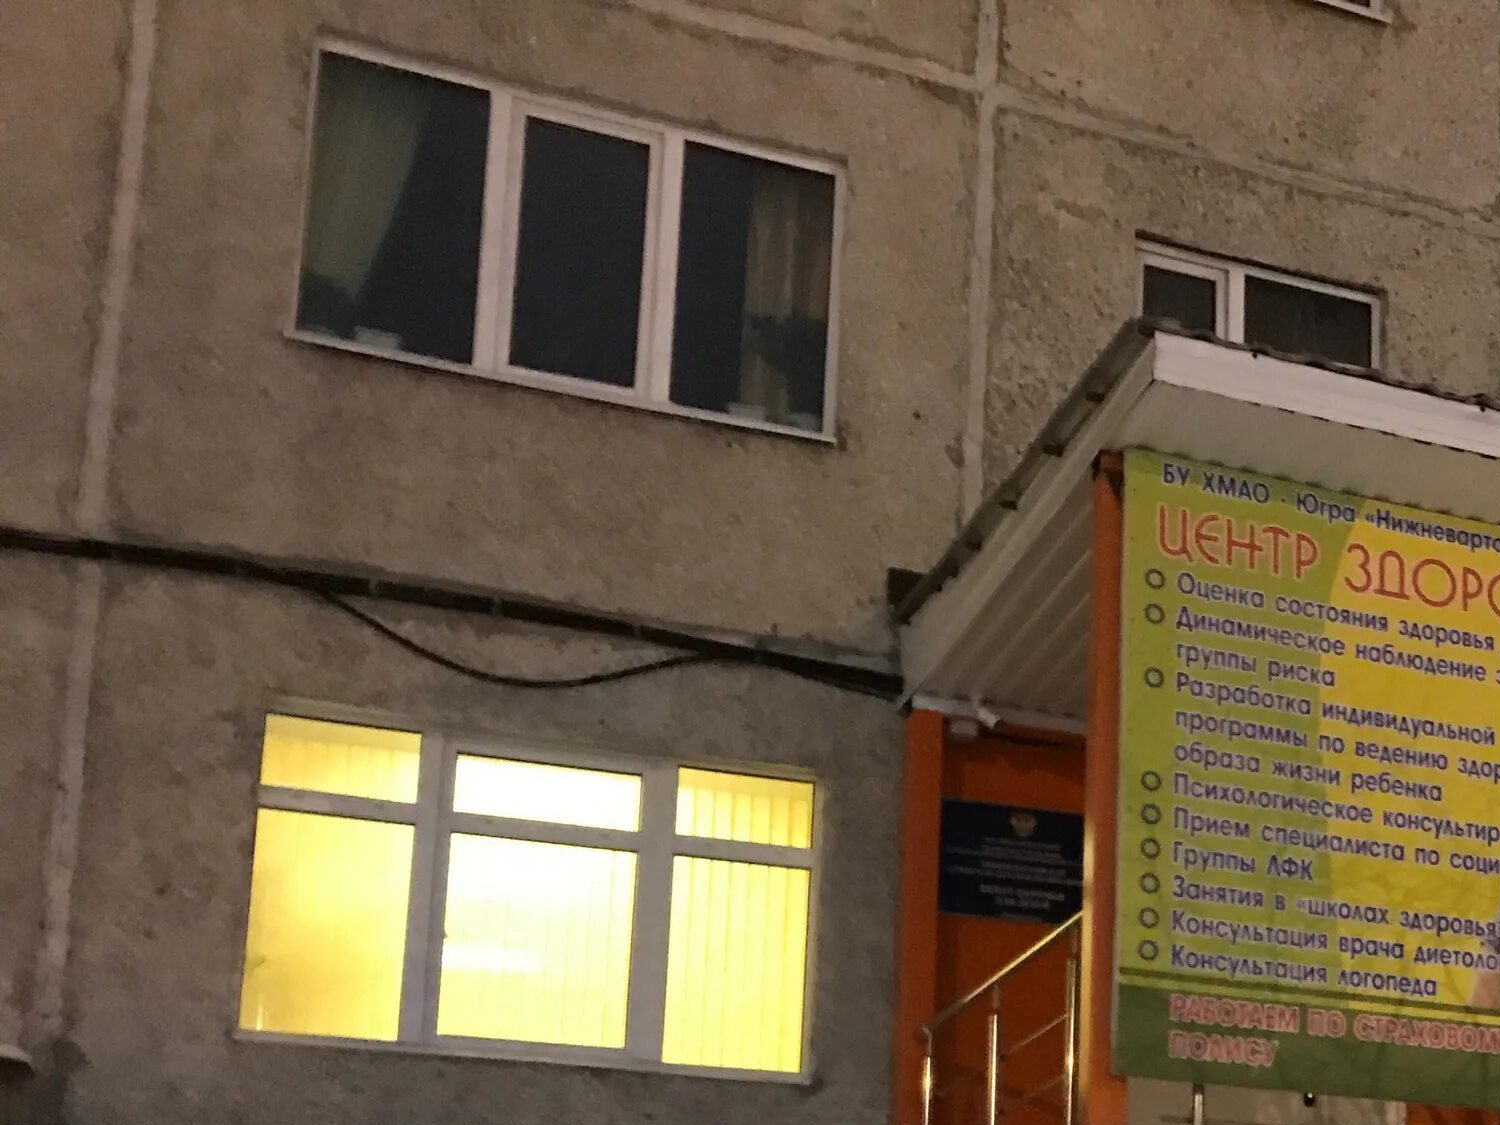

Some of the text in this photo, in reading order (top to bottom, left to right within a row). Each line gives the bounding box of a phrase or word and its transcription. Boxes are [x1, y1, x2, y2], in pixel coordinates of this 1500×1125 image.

[1163, 463, 1189, 486] БУ
[1202, 470, 1269, 503] ХМАО
[1296, 490, 1356, 524] Югра
[1157, 505, 1318, 579] ЦЕНТР
[1177, 572, 1265, 609] Оценка
[1275, 597, 1389, 632] состояния
[1399, 620, 1495, 652] здоровья
[1176, 606, 1345, 656] Динамическое
[1356, 643, 1487, 682] наблюдение
[1176, 643, 1336, 687] группы риска
[1177, 672, 1495, 747] Разработка индивидуальной
[1175, 709, 1308, 748] программы
[1319, 732, 1345, 755] по
[1354, 741, 1448, 771] ведению
[1173, 773, 1373, 823] Психологическое
[1174, 742, 1442, 802] образа жизни ребенка
[1173, 807, 1249, 839] Прием
[1261, 824, 1405, 861] специалиста
[1415, 848, 1440, 867] по
[1173, 841, 1313, 880] Группы ЛФК
[1173, 875, 1263, 909] Занятия
[1274, 894, 1286, 911] в
[1173, 910, 1328, 950] Консультация
[1339, 935, 1405, 961] врача
[1171, 945, 1437, 997] Консультация логопеда
[1169, 994, 1298, 1033] РАБОТАЕМ
[1307, 1010, 1346, 1036] ПО
[1168, 1031, 1279, 1067] ПОЛИСУ
